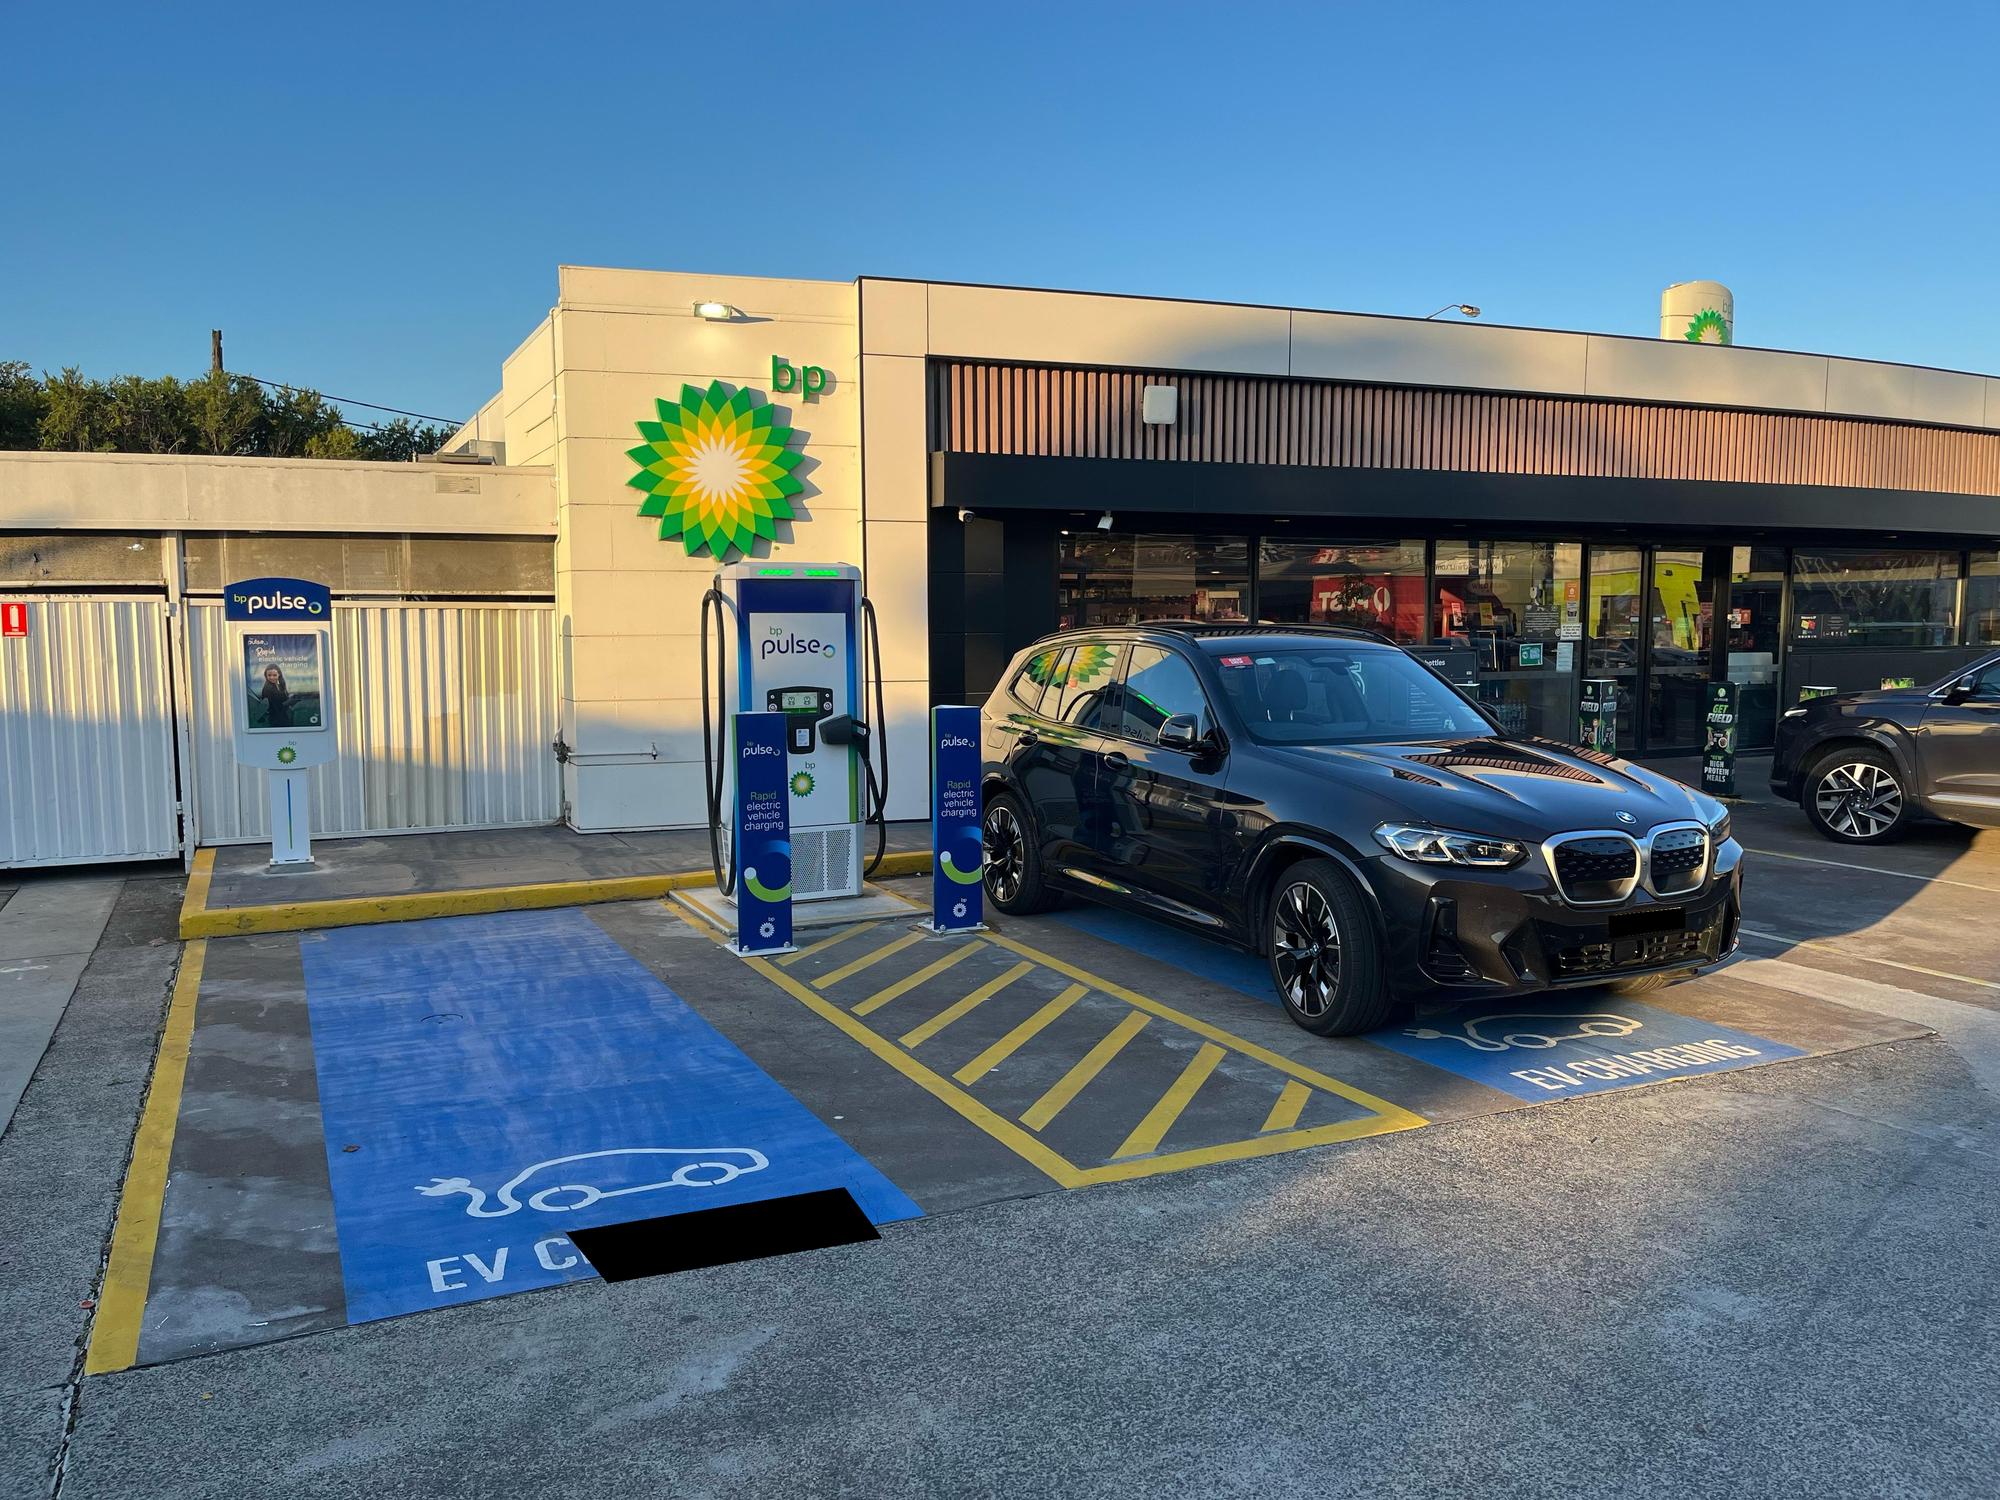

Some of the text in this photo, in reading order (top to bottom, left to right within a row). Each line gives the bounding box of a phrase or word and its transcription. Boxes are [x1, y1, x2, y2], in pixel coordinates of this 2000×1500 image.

[771, 354, 826, 402] bp
[233, 591, 307, 614] bp pulse
[769, 626, 783, 637] bp
[762, 633, 821, 659] pulse
[1712, 704, 1729, 714] GET
[941, 736, 968, 749] pulse
[743, 744, 773, 758] pulse
[805, 761, 816, 770] bp
[1709, 760, 1724, 768] HIGH
[1704, 766, 1730, 776] PROTEIN
[1706, 774, 1726, 783] MEALS
[947, 780, 971, 790] Rapid
[750, 791, 777, 801] Rapid
[943, 790, 975, 799] electric
[746, 801, 781, 811] electric
[944, 799, 974, 808] vehicle
[747, 811, 780, 820] vehicle
[941, 808, 977, 818] charging
[744, 820, 784, 832] charging
[1509, 1039, 1762, 1090] EV CHARGING
[426, 1247, 509, 1293] EV
